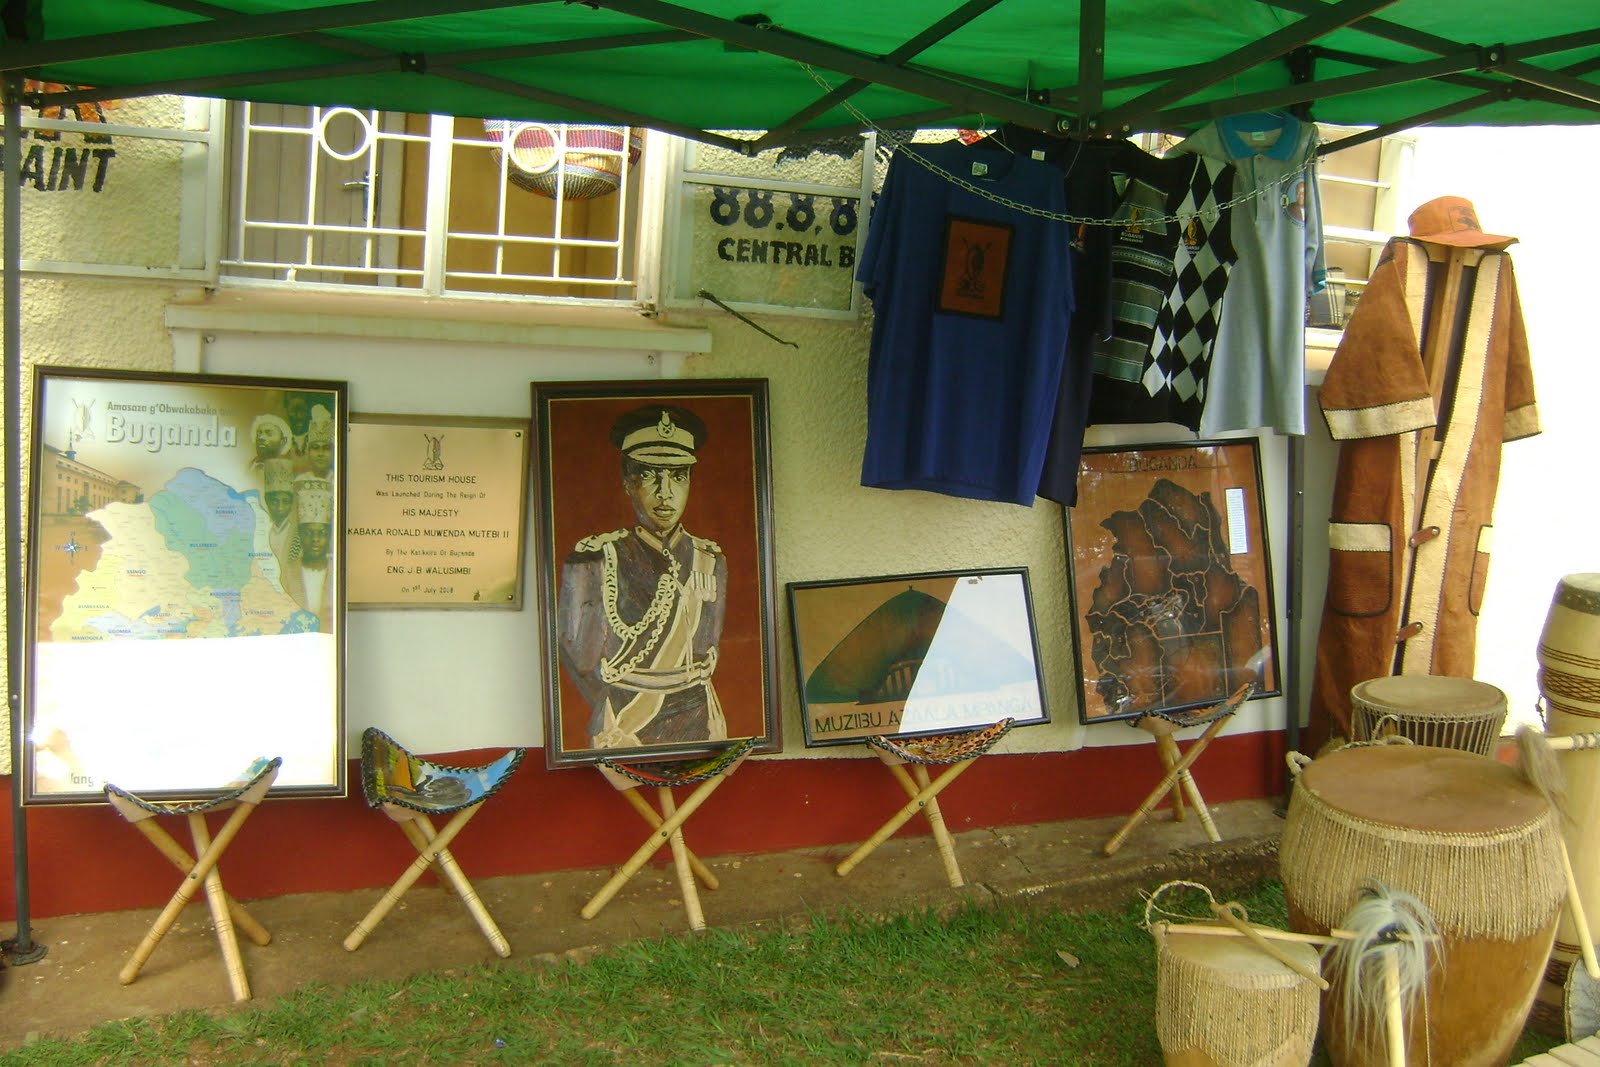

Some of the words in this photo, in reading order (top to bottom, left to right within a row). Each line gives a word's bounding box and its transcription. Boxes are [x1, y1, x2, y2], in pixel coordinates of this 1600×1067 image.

[0, 145, 116, 192] AINT
[717, 237, 832, 267] CENTRAL
[107, 401, 147, 412] Amasaza
[106, 412, 238, 453] Buganda
[386, 474, 405, 482] THIS
[408, 474, 445, 483] TOURISM
[448, 475, 477, 484] HOUSE
[391, 490, 421, 498] Launched
[423, 491, 444, 499] During
[446, 491, 457, 499] The
[459, 492, 477, 500] Reign
[402, 508, 416, 517] HIS
[418, 509, 459, 517] MAJESTY
[347, 528, 383, 536] KABAKA
[386, 528, 421, 537] RONALD
[423, 529, 466, 538] MUWENDA
[468, 530, 500, 539] MUTEBI
[425, 567, 472, 576] WALUSIMBI
[815, 711, 882, 733] MUZIBU
